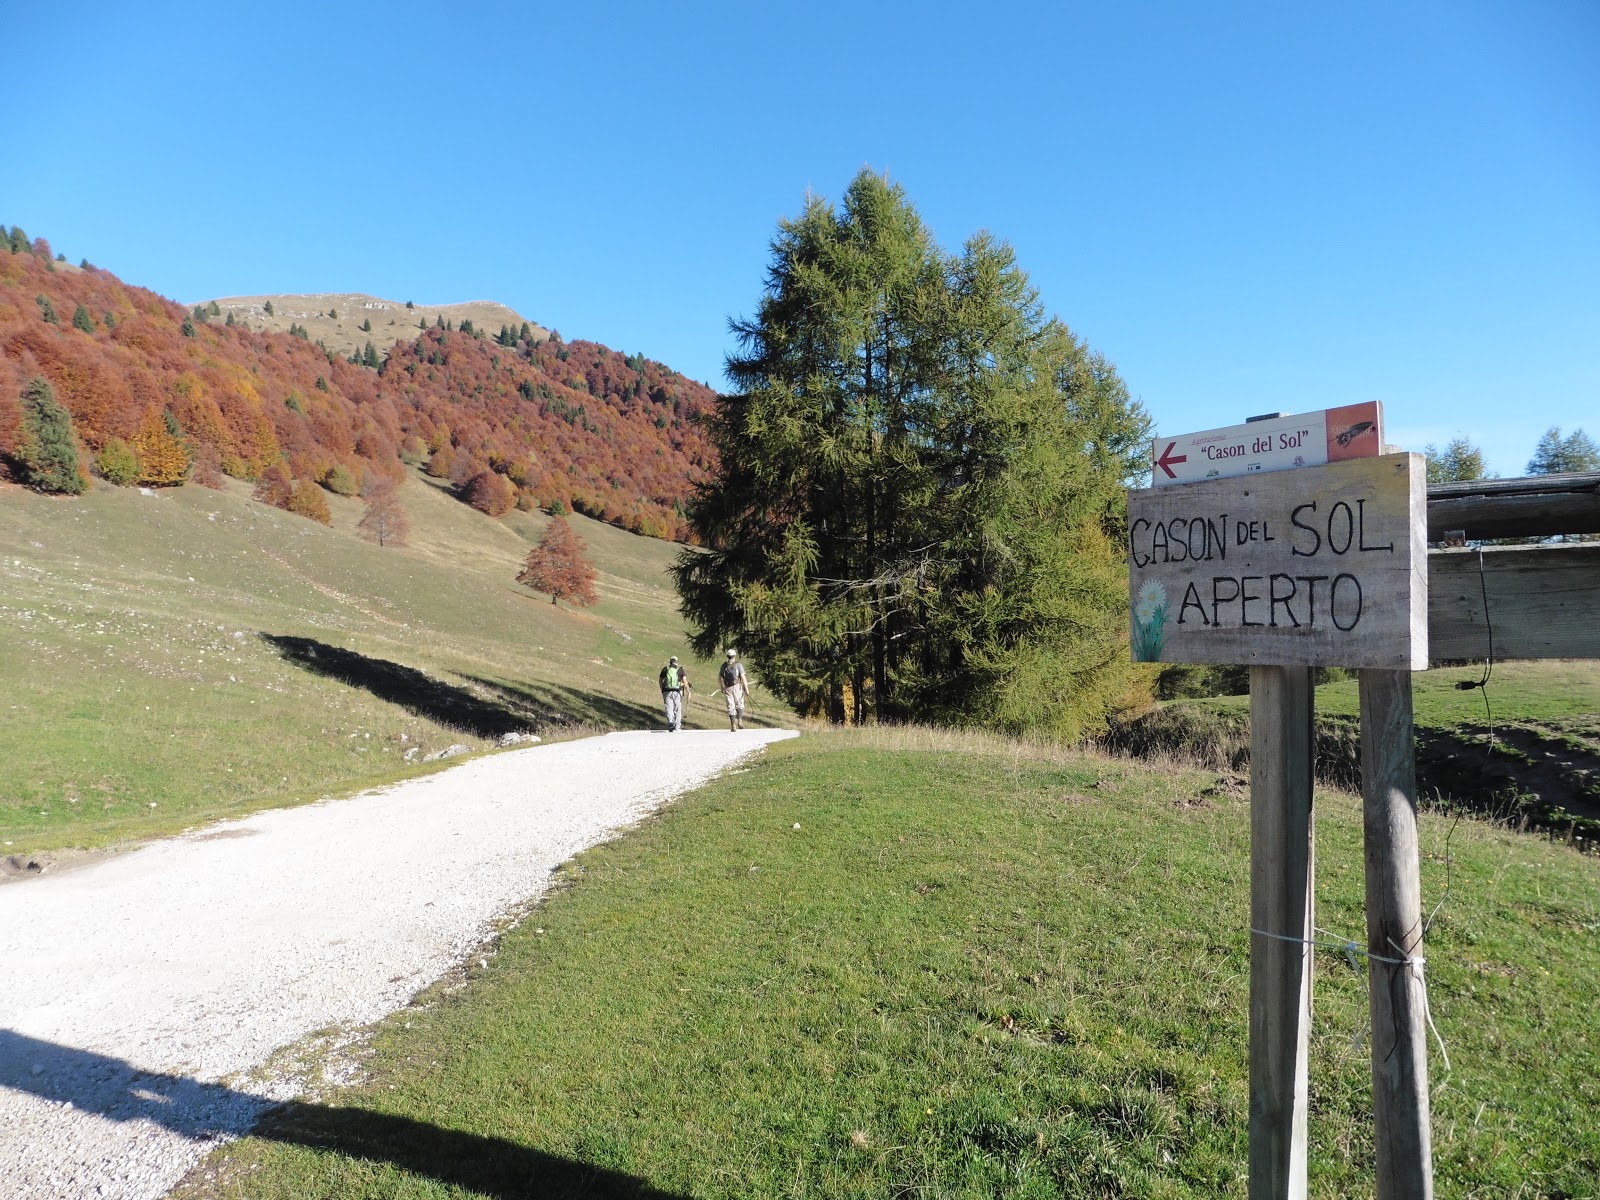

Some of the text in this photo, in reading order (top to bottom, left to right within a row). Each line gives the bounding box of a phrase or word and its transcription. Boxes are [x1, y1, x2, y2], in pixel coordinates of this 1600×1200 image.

[1252, 436, 1272, 453] del
[1130, 499, 1394, 568] CASON DEL SOL
[1177, 572, 1363, 632] APERTO
